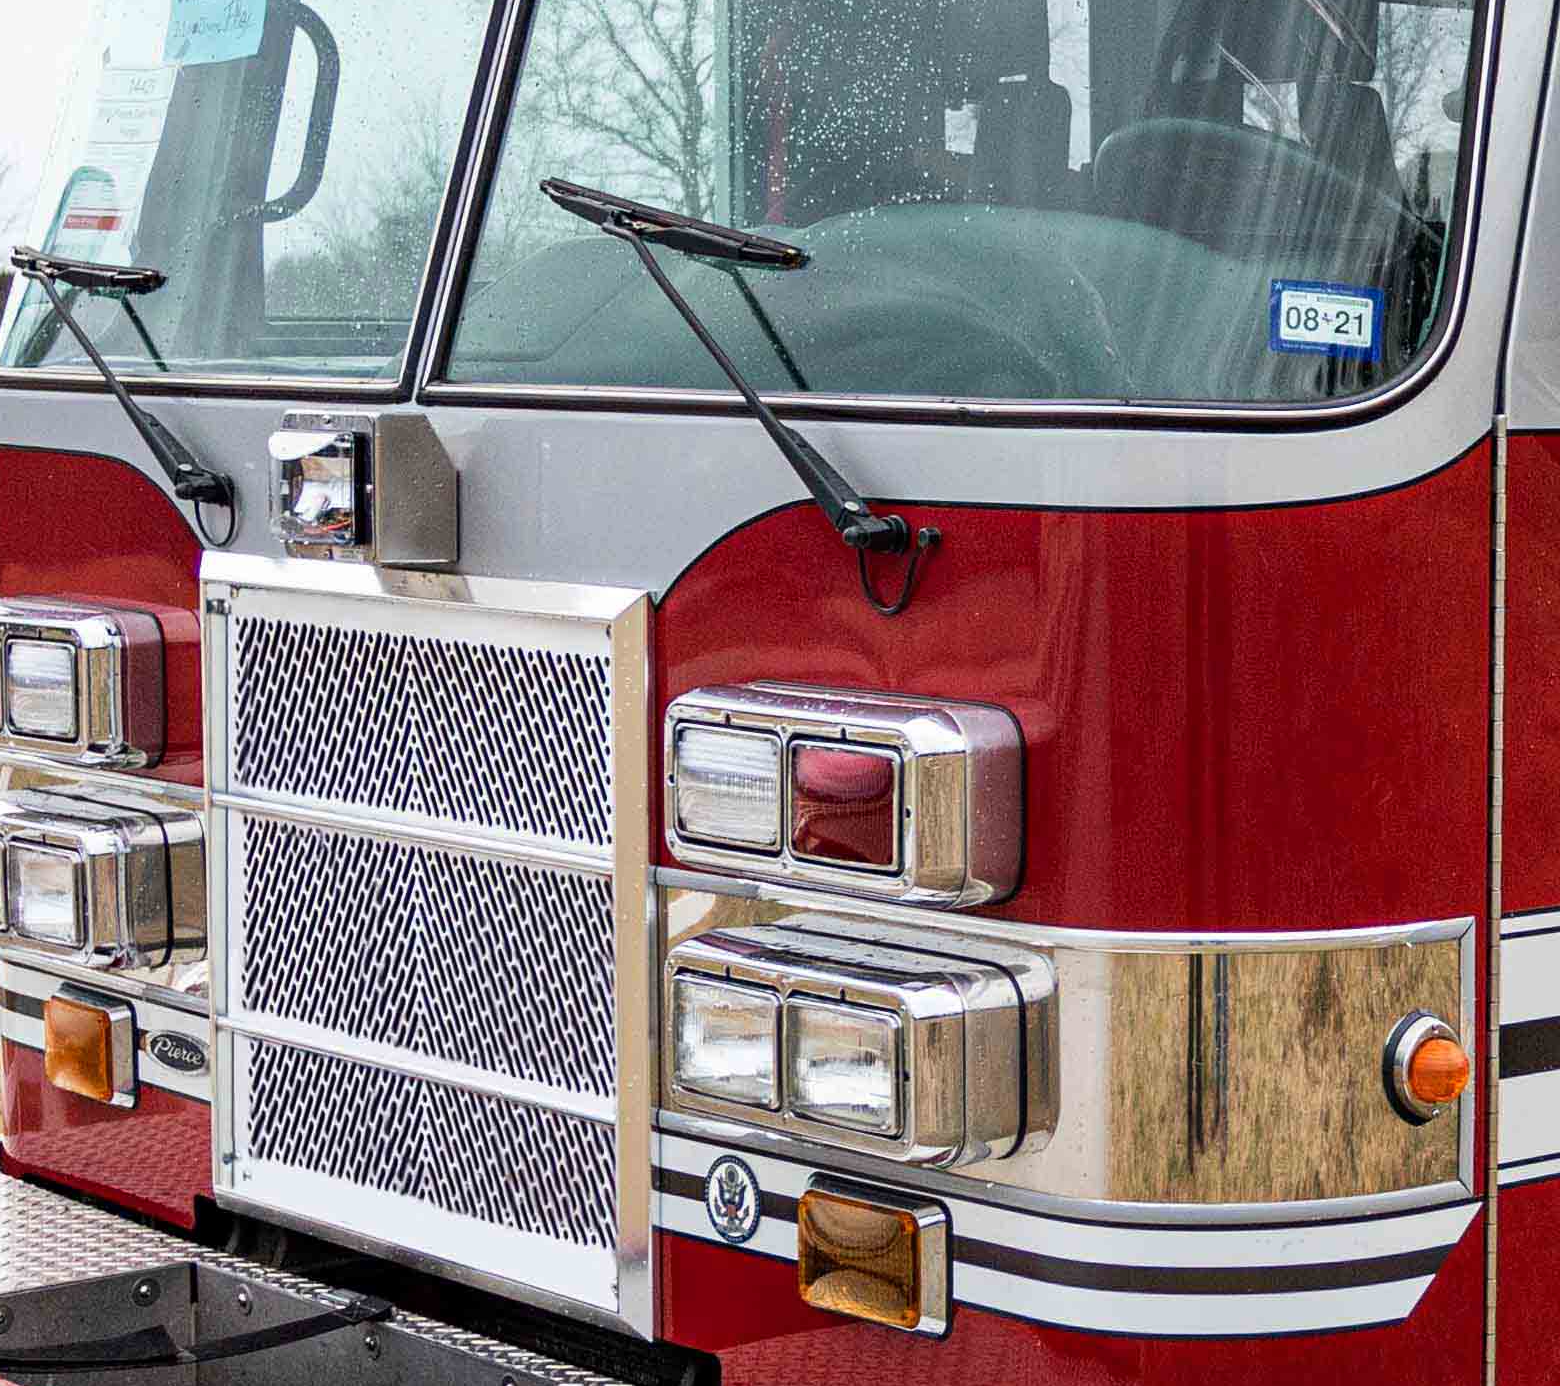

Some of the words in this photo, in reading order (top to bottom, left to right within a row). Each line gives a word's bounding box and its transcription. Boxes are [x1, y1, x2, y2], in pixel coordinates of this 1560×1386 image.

[1286, 306, 1320, 331] 08
[1334, 311, 1364, 337] 21
[153, 1036, 203, 1066] Pierce
